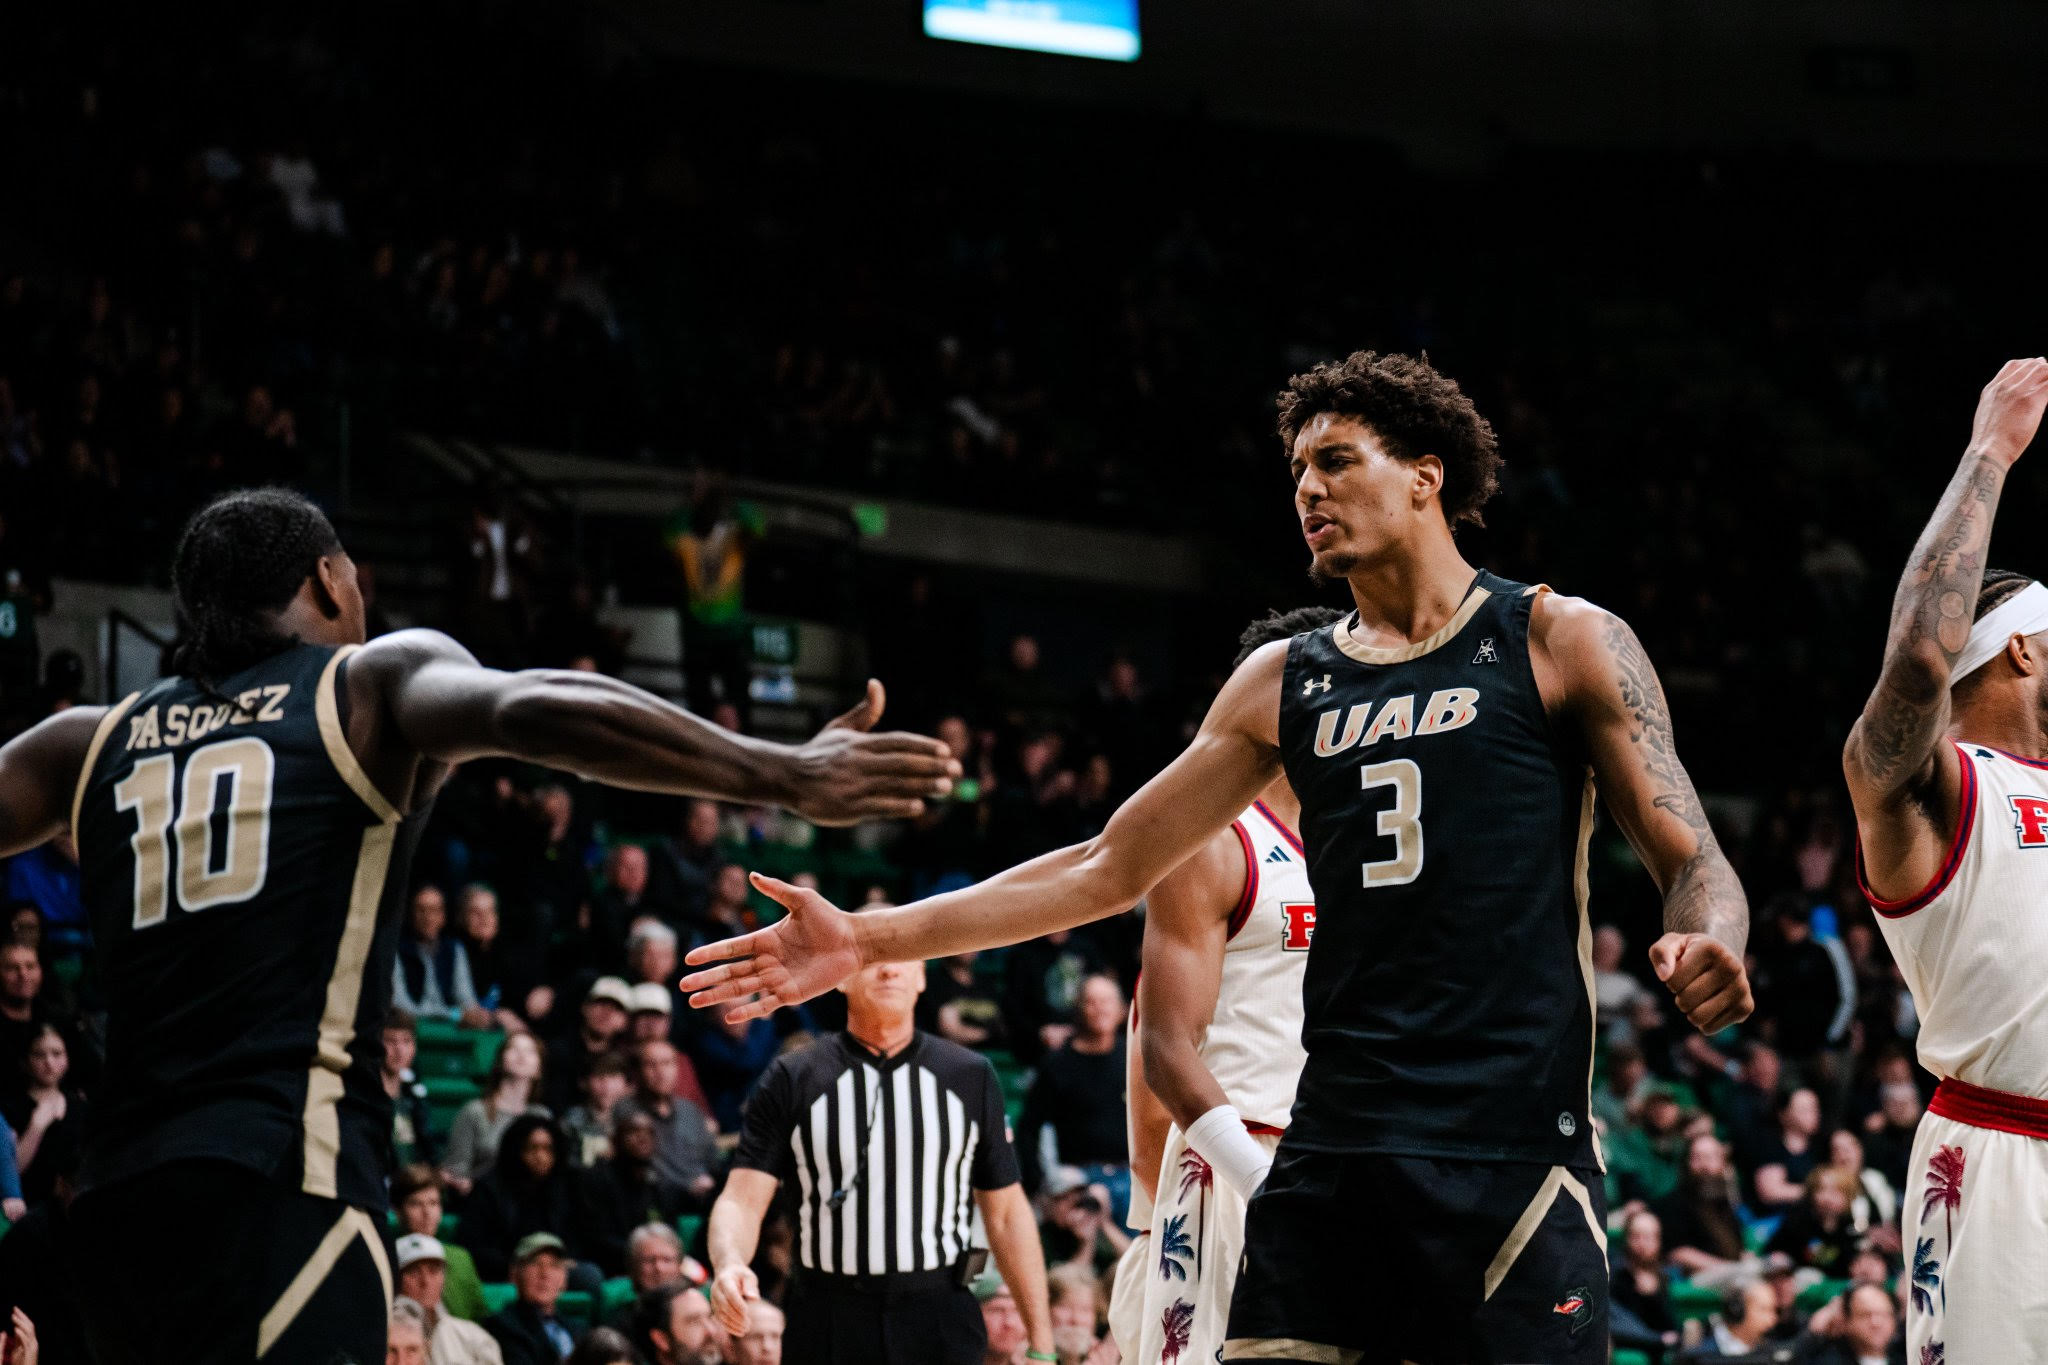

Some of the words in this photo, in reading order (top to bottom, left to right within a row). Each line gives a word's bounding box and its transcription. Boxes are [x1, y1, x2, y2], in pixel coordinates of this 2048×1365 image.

[1313, 687, 1480, 758] UAB
[114, 736, 275, 931] 10
[1361, 758, 1424, 889] 3
